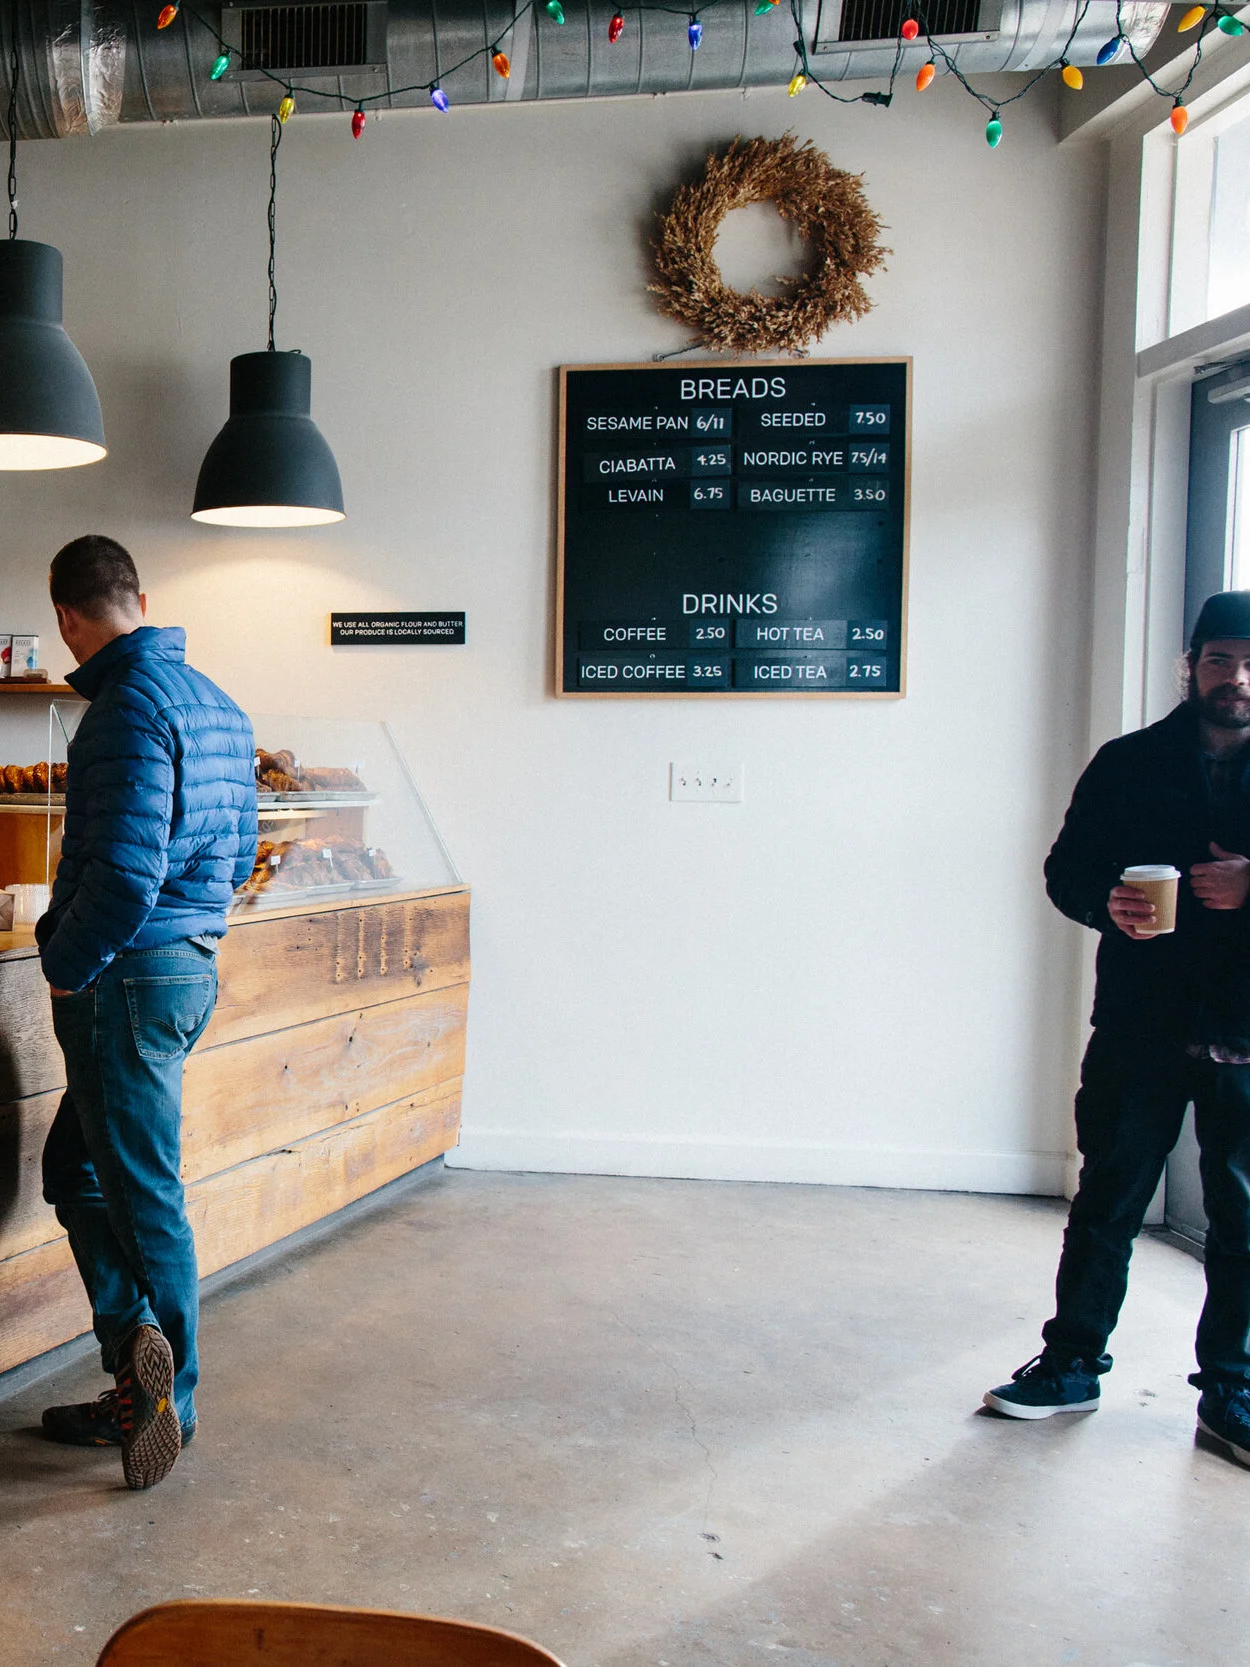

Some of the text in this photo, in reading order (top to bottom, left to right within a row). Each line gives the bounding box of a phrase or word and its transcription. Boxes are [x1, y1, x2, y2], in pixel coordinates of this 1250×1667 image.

[681, 377, 785, 399] BREADS
[587, 415, 723, 431] SESAME PAN 6/11
[761, 413, 825, 426] SEEDED
[600, 457, 675, 473] CIABATTA
[744, 452, 806, 465] NORDIC
[813, 452, 842, 464] RYE
[609, 488, 722, 502] LEVAIN 6.75
[751, 489, 885, 502] BAGUETTE 3.50
[683, 594, 777, 614] DRINKS
[604, 627, 725, 641] COFFEE 2.50
[757, 628, 883, 640] HOT TEA 2.50
[582, 666, 721, 678] ICED COFFEE 3.25
[755, 665, 880, 678] ICED TEA 2.75
